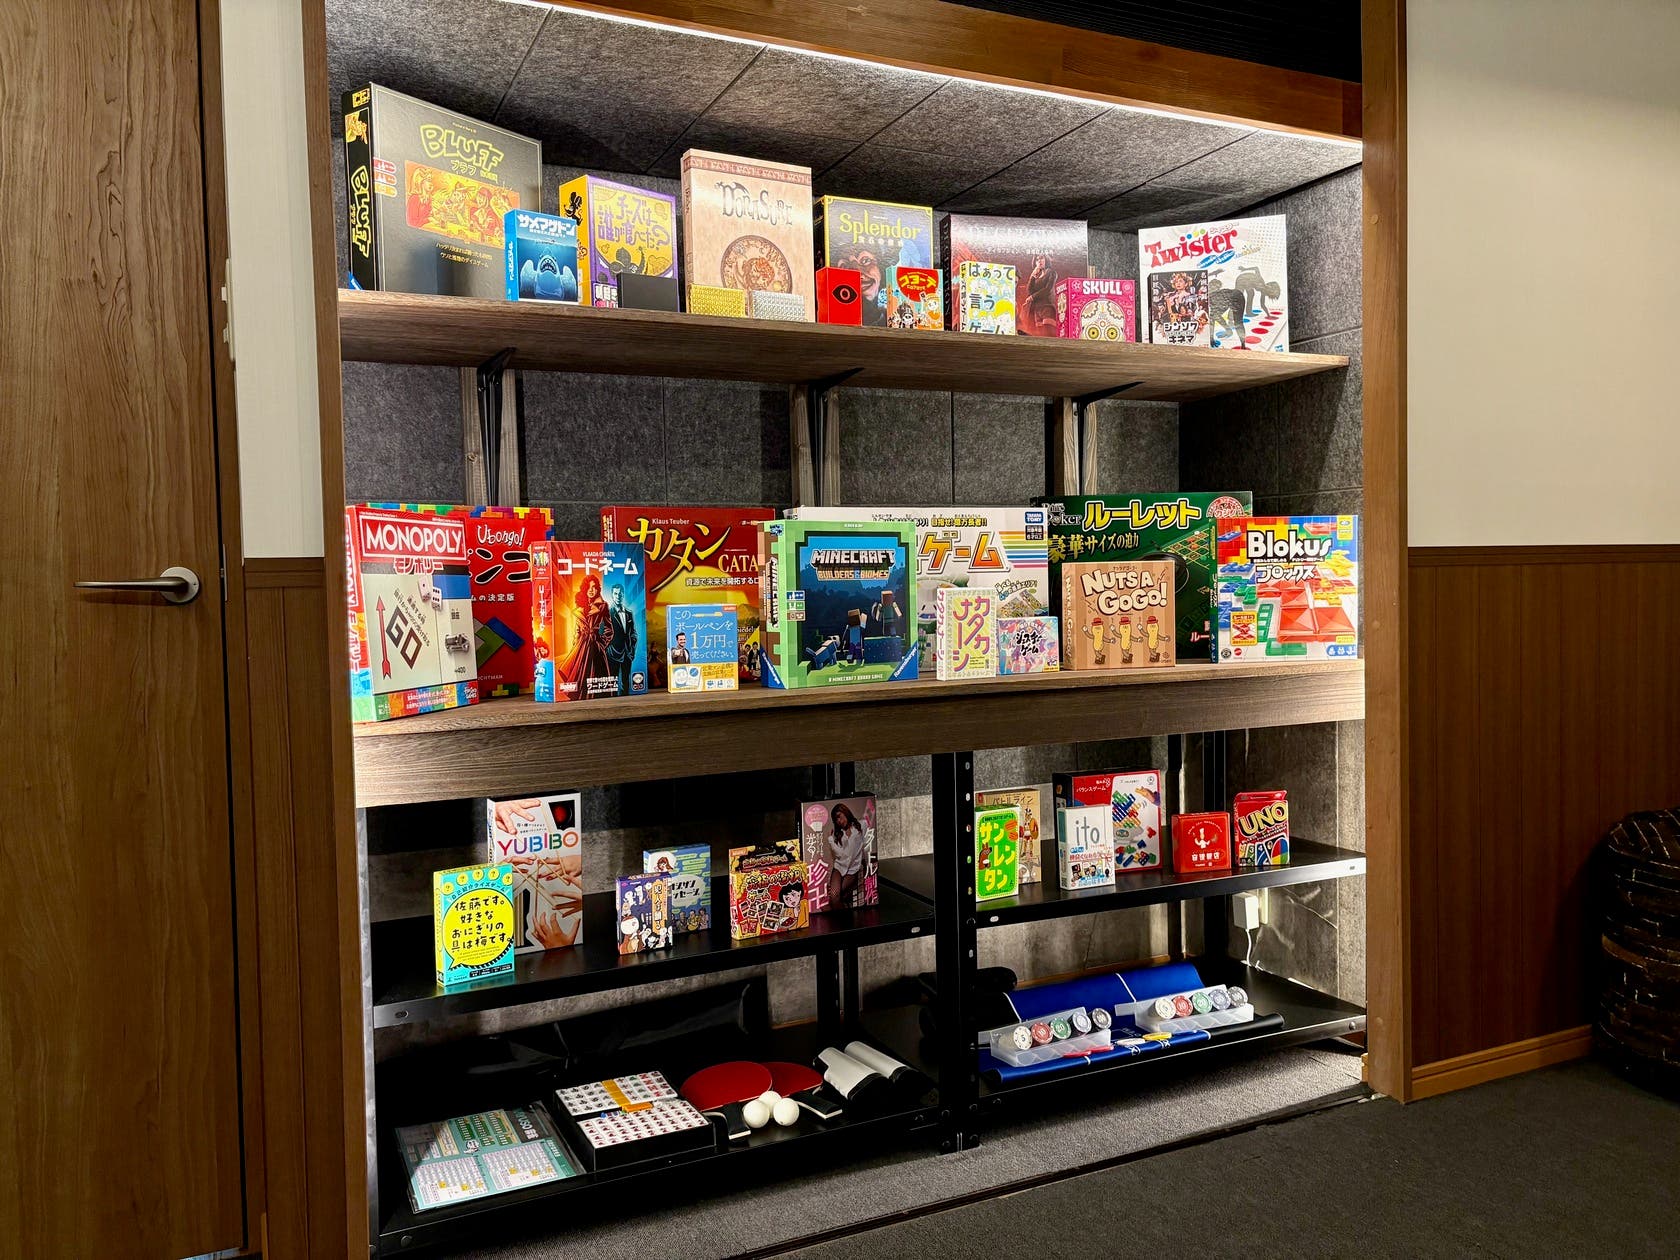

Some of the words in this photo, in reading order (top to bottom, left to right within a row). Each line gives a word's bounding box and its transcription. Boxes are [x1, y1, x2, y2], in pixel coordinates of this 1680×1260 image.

[420, 124, 504, 171] BLUFF
[450, 159, 476, 176] ブラフ
[616, 196, 657, 226] チーズは
[840, 209, 920, 243] Splendor
[1144, 229, 1237, 268] Twister
[1083, 280, 1122, 295] SKULL
[969, 293, 995, 310] 言う
[1083, 498, 1201, 531] ルーレット
[366, 523, 462, 553] MONOPOLY
[477, 524, 526, 546] Ubongo!
[1247, 530, 1332, 560] Blokus
[627, 518, 730, 592] カタン
[811, 549, 896, 567] MINECRAFT
[918, 530, 1010, 573] ゲーム
[1048, 532, 1139, 563] 豪華サイズの迫力
[394, 558, 443, 574] モノポリー
[558, 557, 638, 575] コードネーム
[718, 554, 759, 573] CATA
[818, 569, 855, 580] BUILDERS
[860, 569, 889, 580] BIOMES
[1081, 569, 1139, 596] NUTS
[1139, 572, 1154, 588] A
[1256, 565, 1316, 584] ブロックス
[1097, 582, 1167, 615] GOGO!
[675, 610, 691, 620] この
[676, 620, 733, 631] ボールペンを
[386, 605, 422, 669] GO
[691, 632, 733, 650] 1万円で
[993, 795, 1033, 805] バトルライン
[1239, 801, 1288, 836] UNO
[497, 831, 579, 856] YUBIBO
[1075, 816, 1100, 850] ito
[454, 895, 504, 912] 佐藤です。
[460, 910, 493, 923] 好きな
[452, 921, 504, 938] おにぎりの
[452, 932, 511, 952] 具は梅です。
